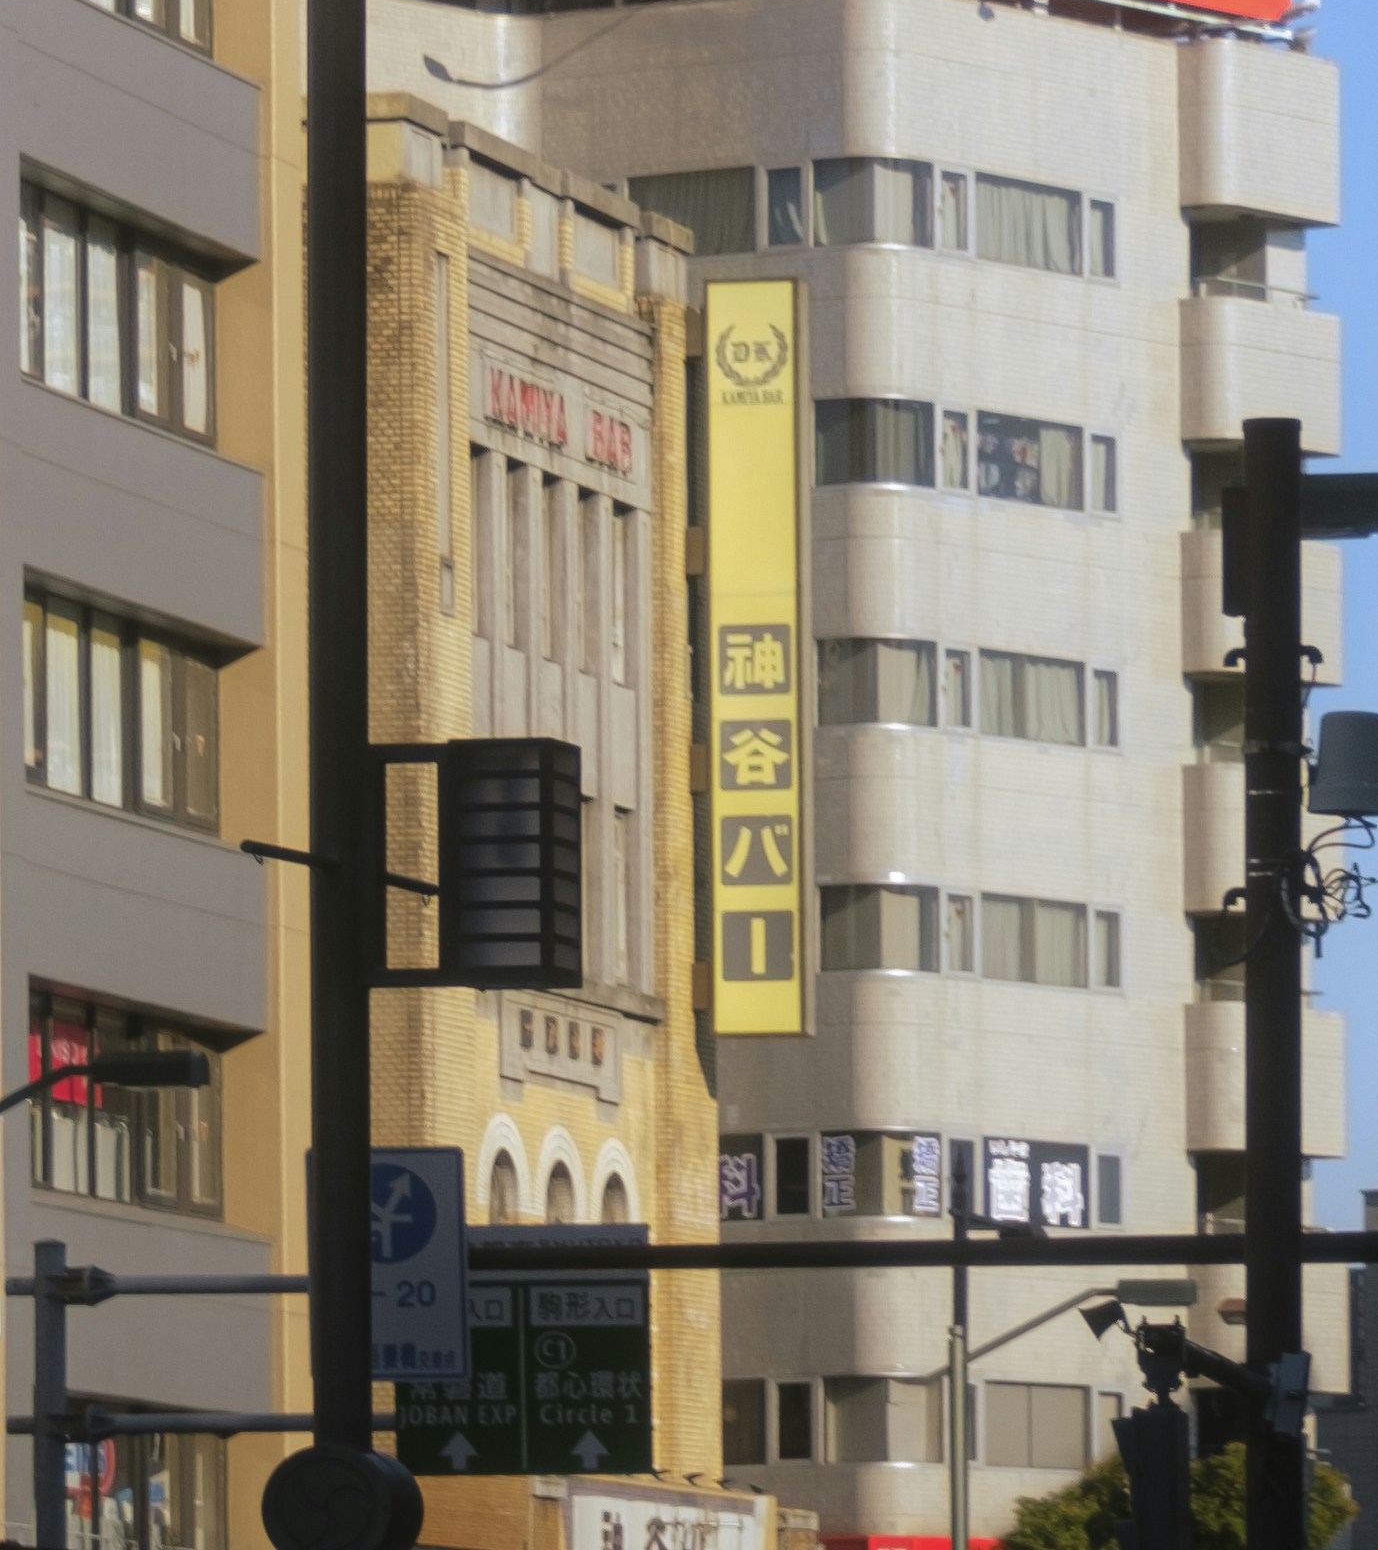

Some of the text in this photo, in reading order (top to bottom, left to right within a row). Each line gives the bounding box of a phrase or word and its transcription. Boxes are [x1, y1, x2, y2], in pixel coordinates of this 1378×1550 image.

[723, 631, 790, 976] 神谷バー
[398, 1403, 519, 1431] JOBAN EXP
[538, 1403, 639, 1426] Circle 1
